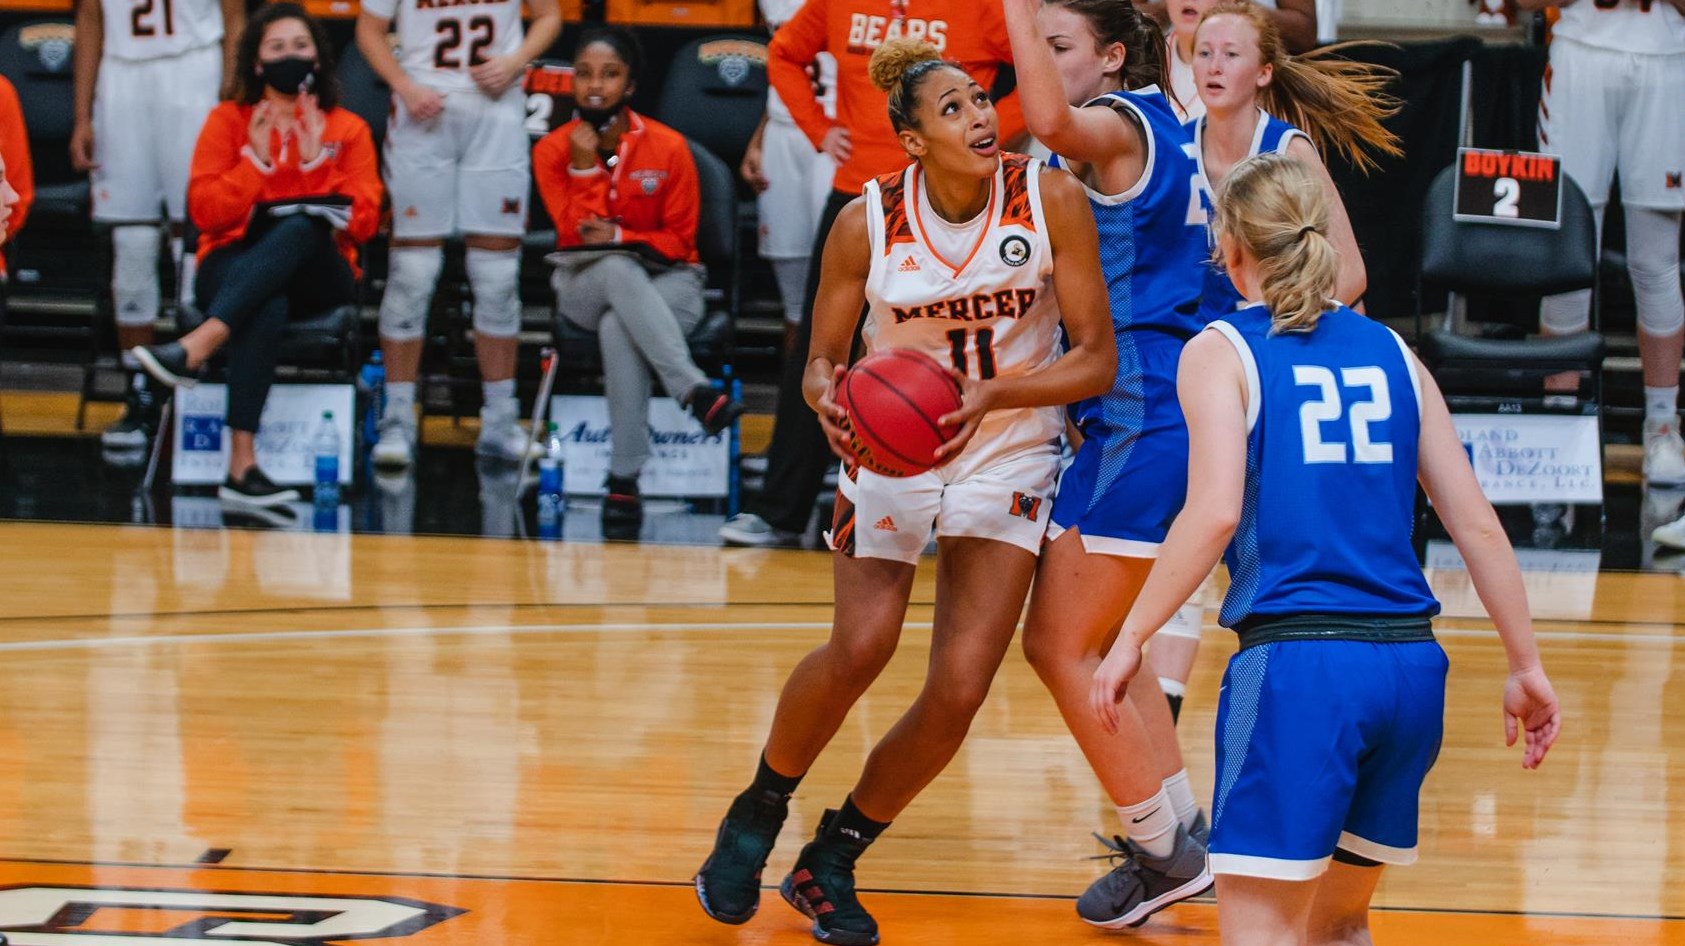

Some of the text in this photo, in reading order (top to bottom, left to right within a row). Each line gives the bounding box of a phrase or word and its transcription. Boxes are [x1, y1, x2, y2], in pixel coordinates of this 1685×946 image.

[131, 0, 173, 36] 21
[849, 12, 948, 54] BEARS
[433, 15, 495, 68] 22
[1464, 150, 1554, 181] BOYKIN
[1493, 177, 1520, 218] 2
[891, 288, 1036, 324] MERCER
[945, 326, 998, 380] 11
[555, 421, 611, 443] Aut
[1292, 364, 1394, 464] 22
